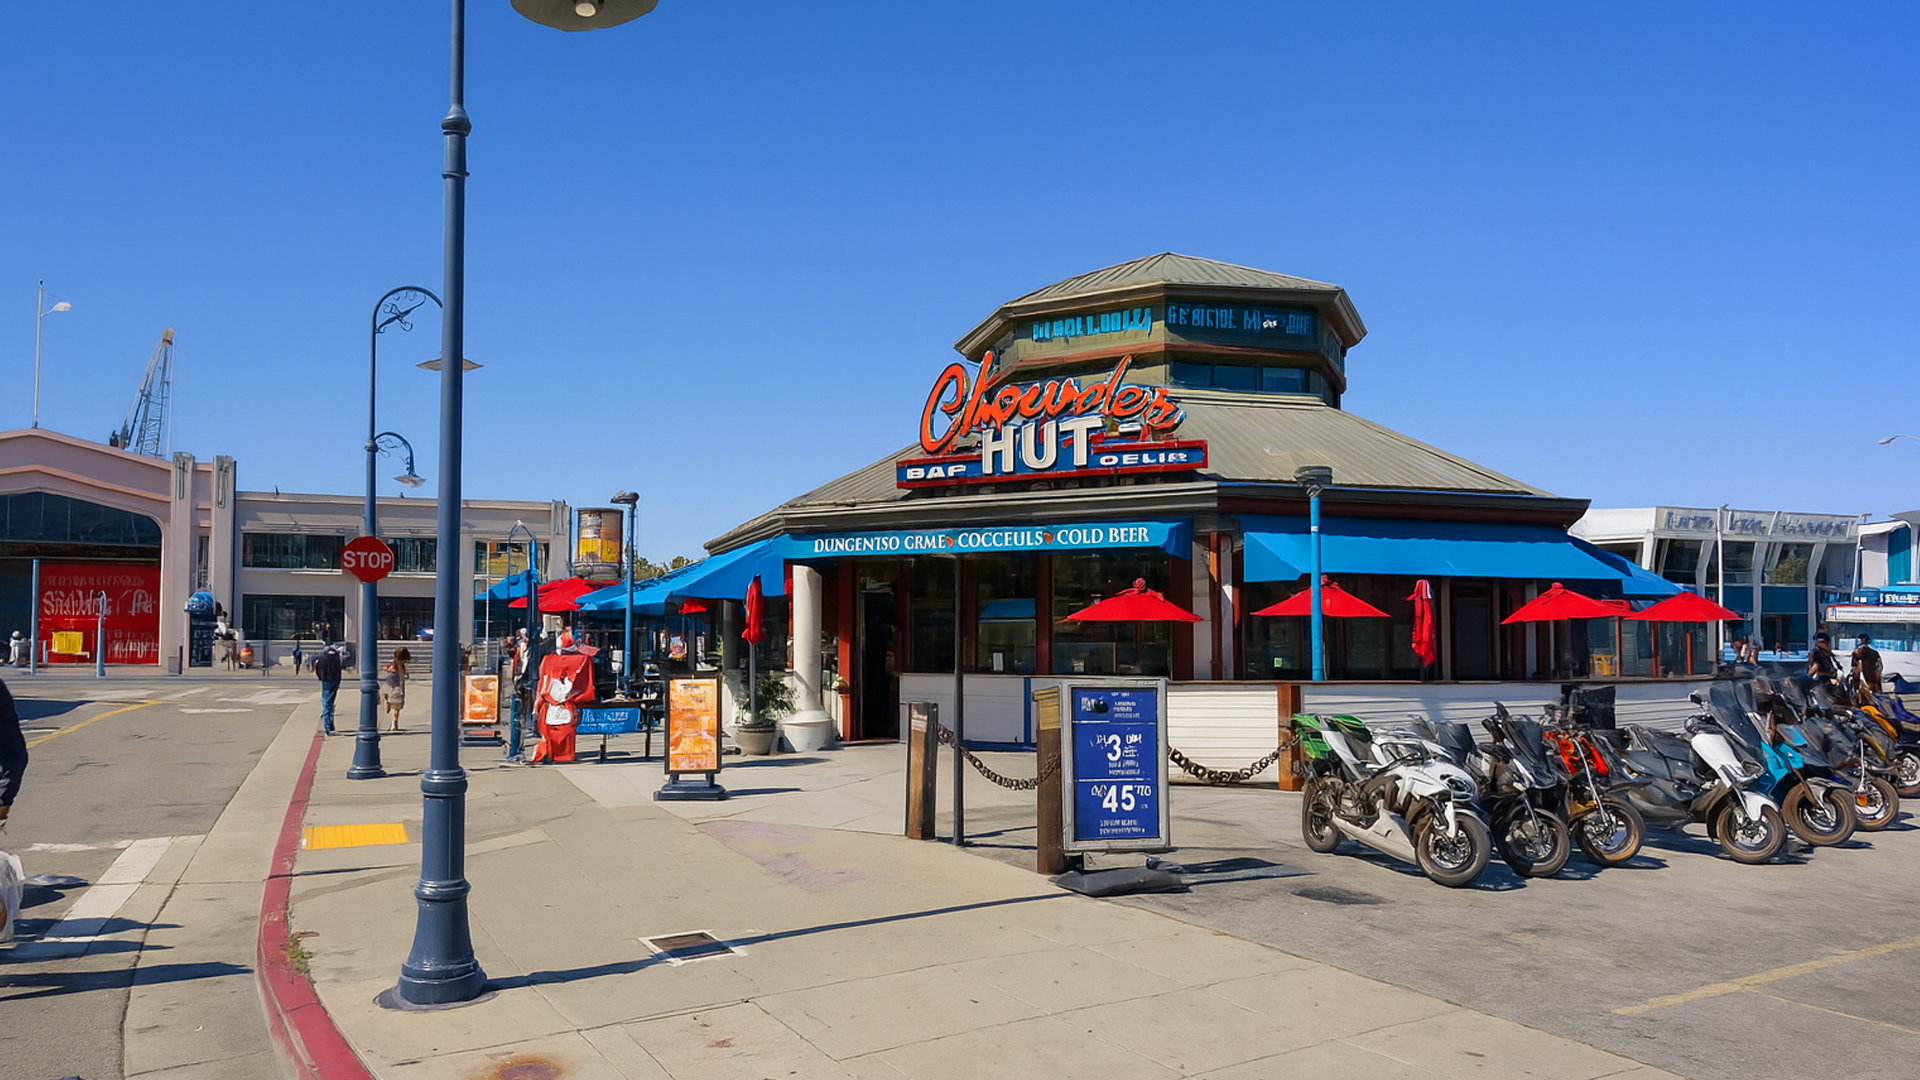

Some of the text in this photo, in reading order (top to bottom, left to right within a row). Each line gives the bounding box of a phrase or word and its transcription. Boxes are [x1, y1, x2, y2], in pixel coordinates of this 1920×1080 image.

[982, 416, 1103, 474] HUT
[1056, 528, 1103, 545] COLD
[1108, 527, 1149, 543] BEER
[343, 550, 392, 569] STOP
[1107, 734, 1121, 761] 3
[1103, 785, 1135, 812] 45
